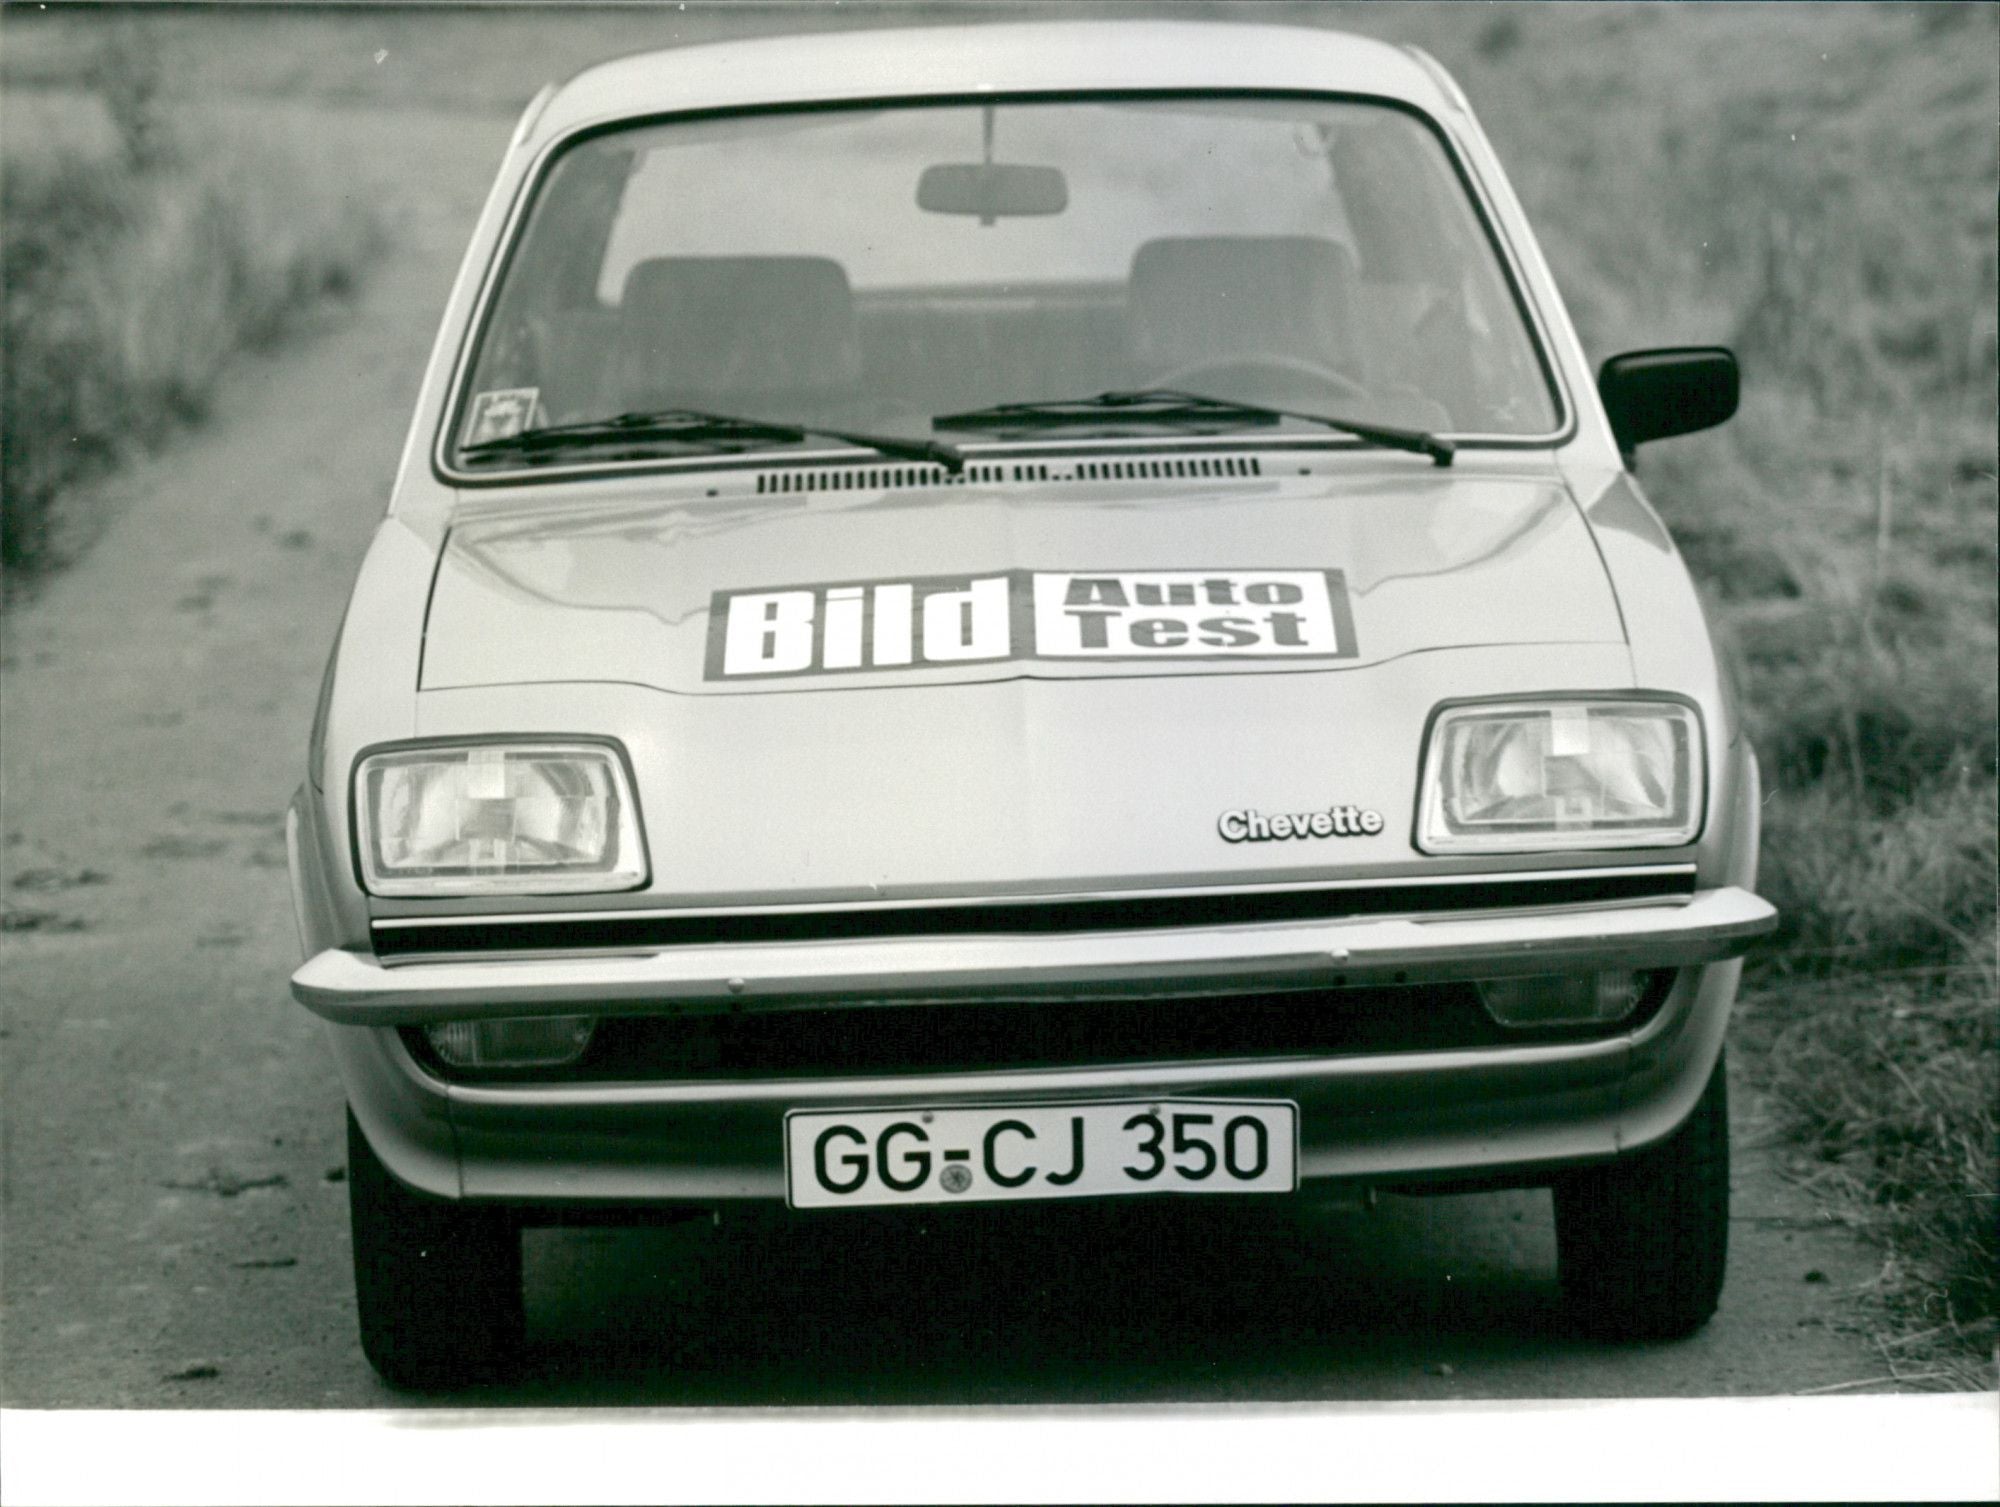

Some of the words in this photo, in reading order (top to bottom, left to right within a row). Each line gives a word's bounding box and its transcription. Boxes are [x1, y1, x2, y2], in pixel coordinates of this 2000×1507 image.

[1063, 578, 1304, 606] Auto
[724, 577, 1010, 674] Bild
[1063, 610, 1310, 649] Test
[1218, 805, 1384, 843] Chevette
[1122, 1113, 1269, 1181] 350
